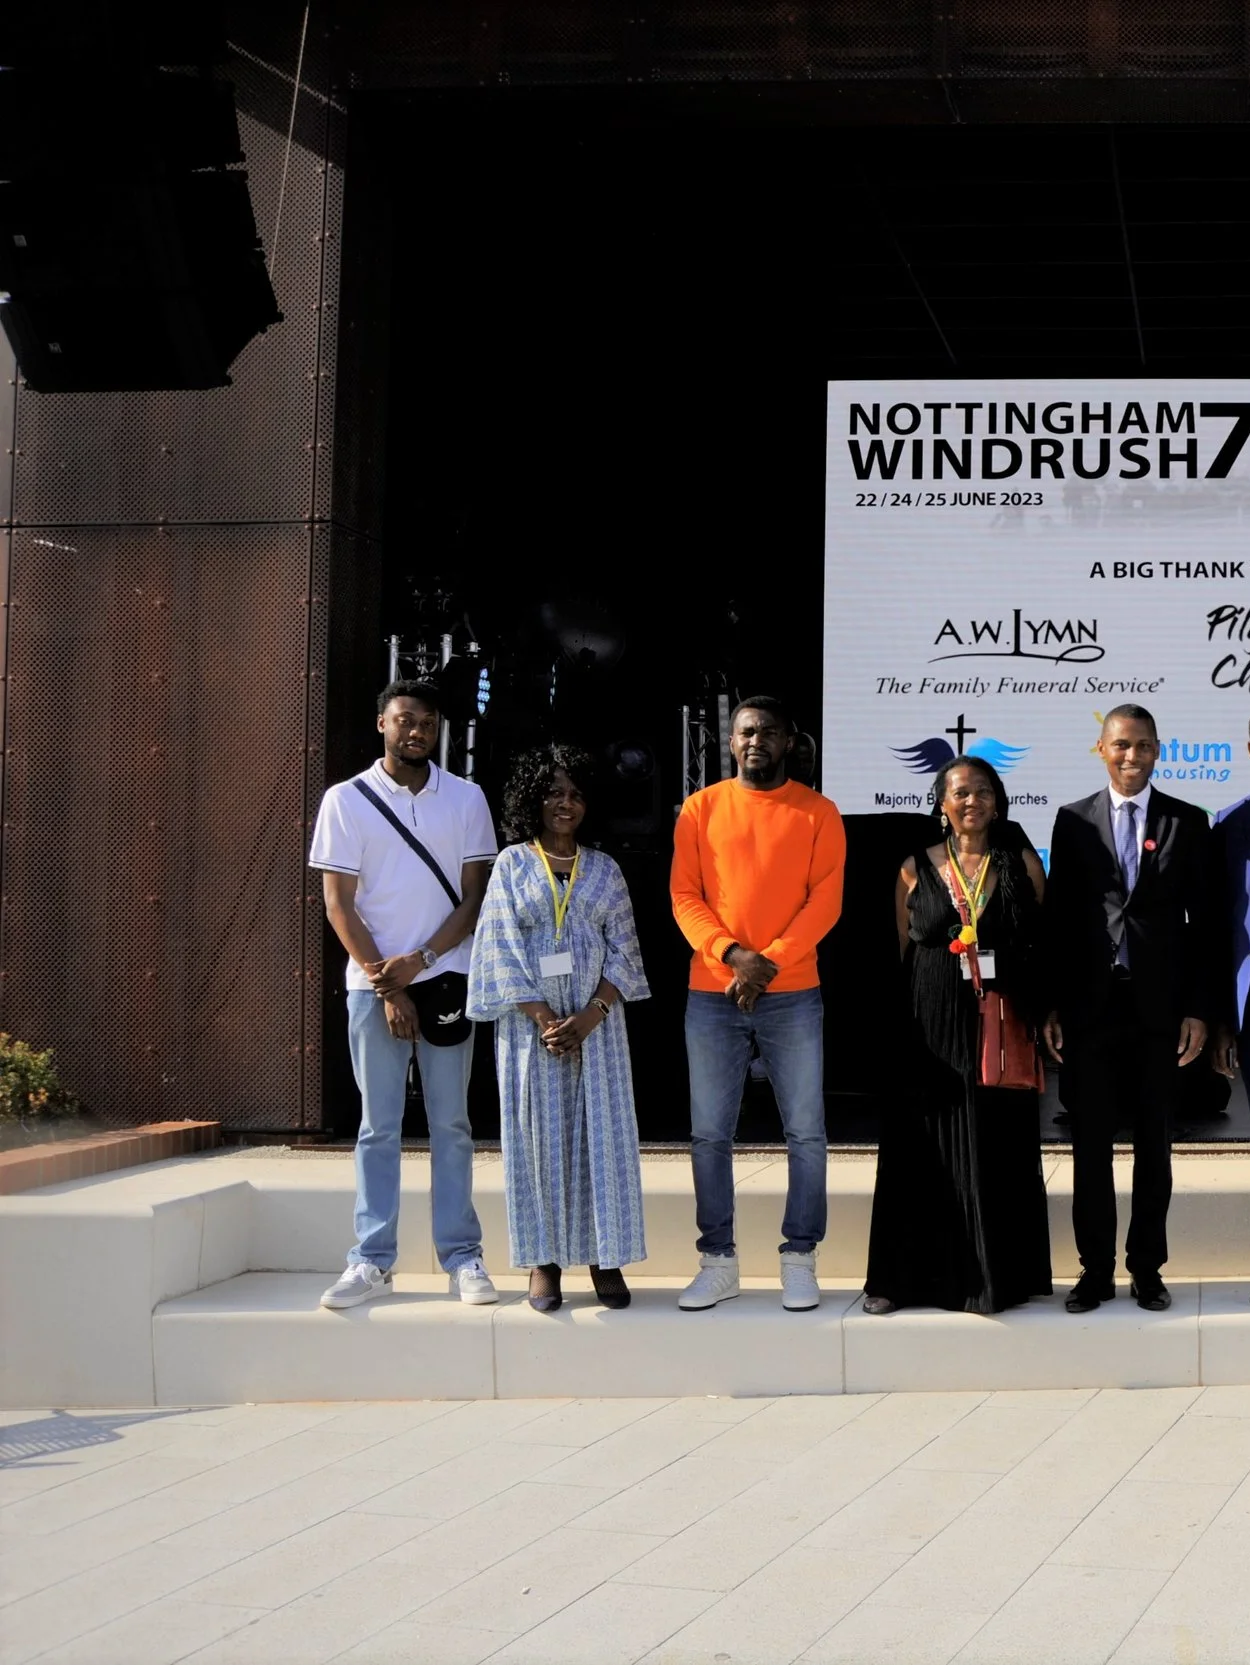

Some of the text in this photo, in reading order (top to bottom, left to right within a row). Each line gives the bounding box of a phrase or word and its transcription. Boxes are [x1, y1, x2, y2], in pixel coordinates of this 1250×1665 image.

[850, 402, 1196, 435] NOTTINGHAM
[848, 438, 1198, 480] WINDRUSH
[950, 492, 996, 507] JUNE
[1000, 492, 1044, 506] 2023
[1089, 561, 1106, 580] A
[1113, 561, 1154, 580] BIG
[1160, 561, 1245, 580] THANK
[876, 676, 912, 694] The
[919, 676, 990, 698] Family
[996, 676, 1078, 694] Funeral
[1159, 738, 1232, 762] ntum
[874, 792, 923, 809] Majority
[1007, 792, 1048, 805] urches
